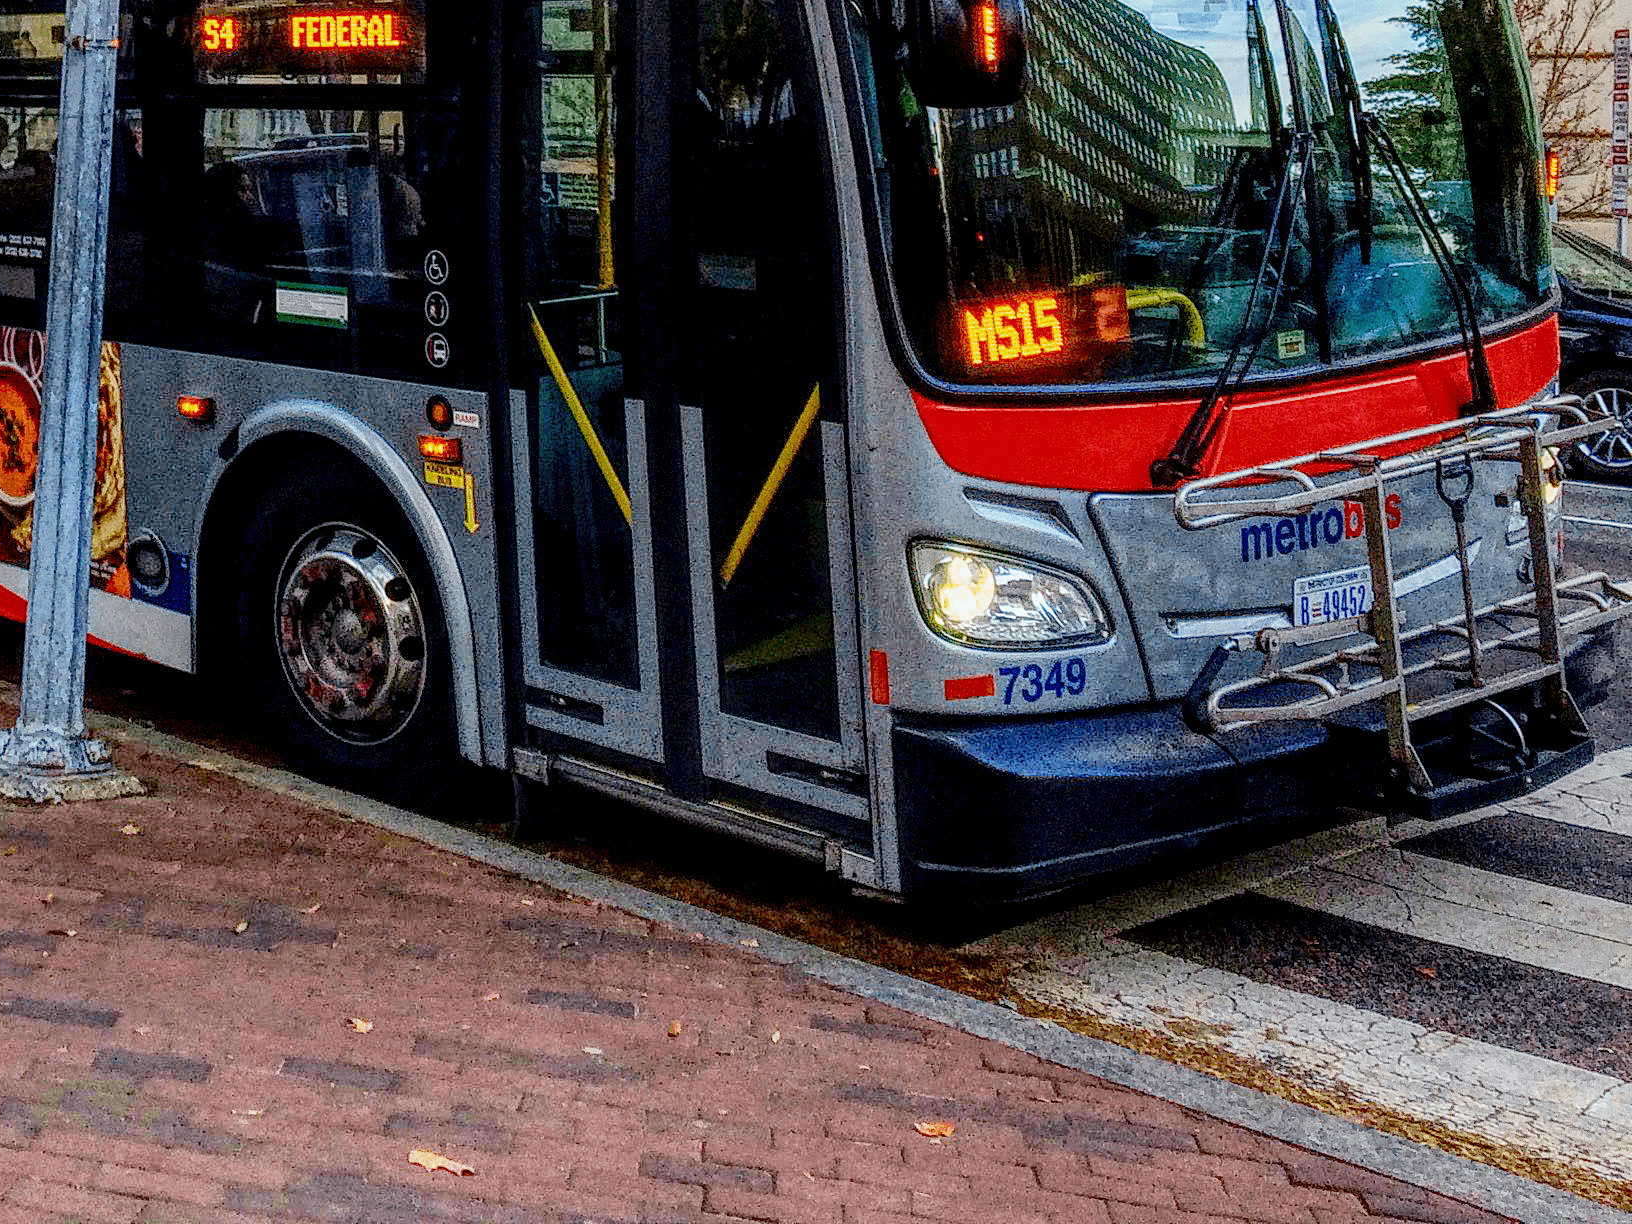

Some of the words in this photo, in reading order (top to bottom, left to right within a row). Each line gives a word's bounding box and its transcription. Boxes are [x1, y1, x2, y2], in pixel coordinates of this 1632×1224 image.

[204, 17, 236, 50] S4
[291, 13, 400, 48] FEDERAL
[455, 413, 477, 424] RAMP
[1240, 493, 1402, 563] metrobs
[1323, 584, 1366, 623] 49452
[998, 657, 1087, 705] 7349
